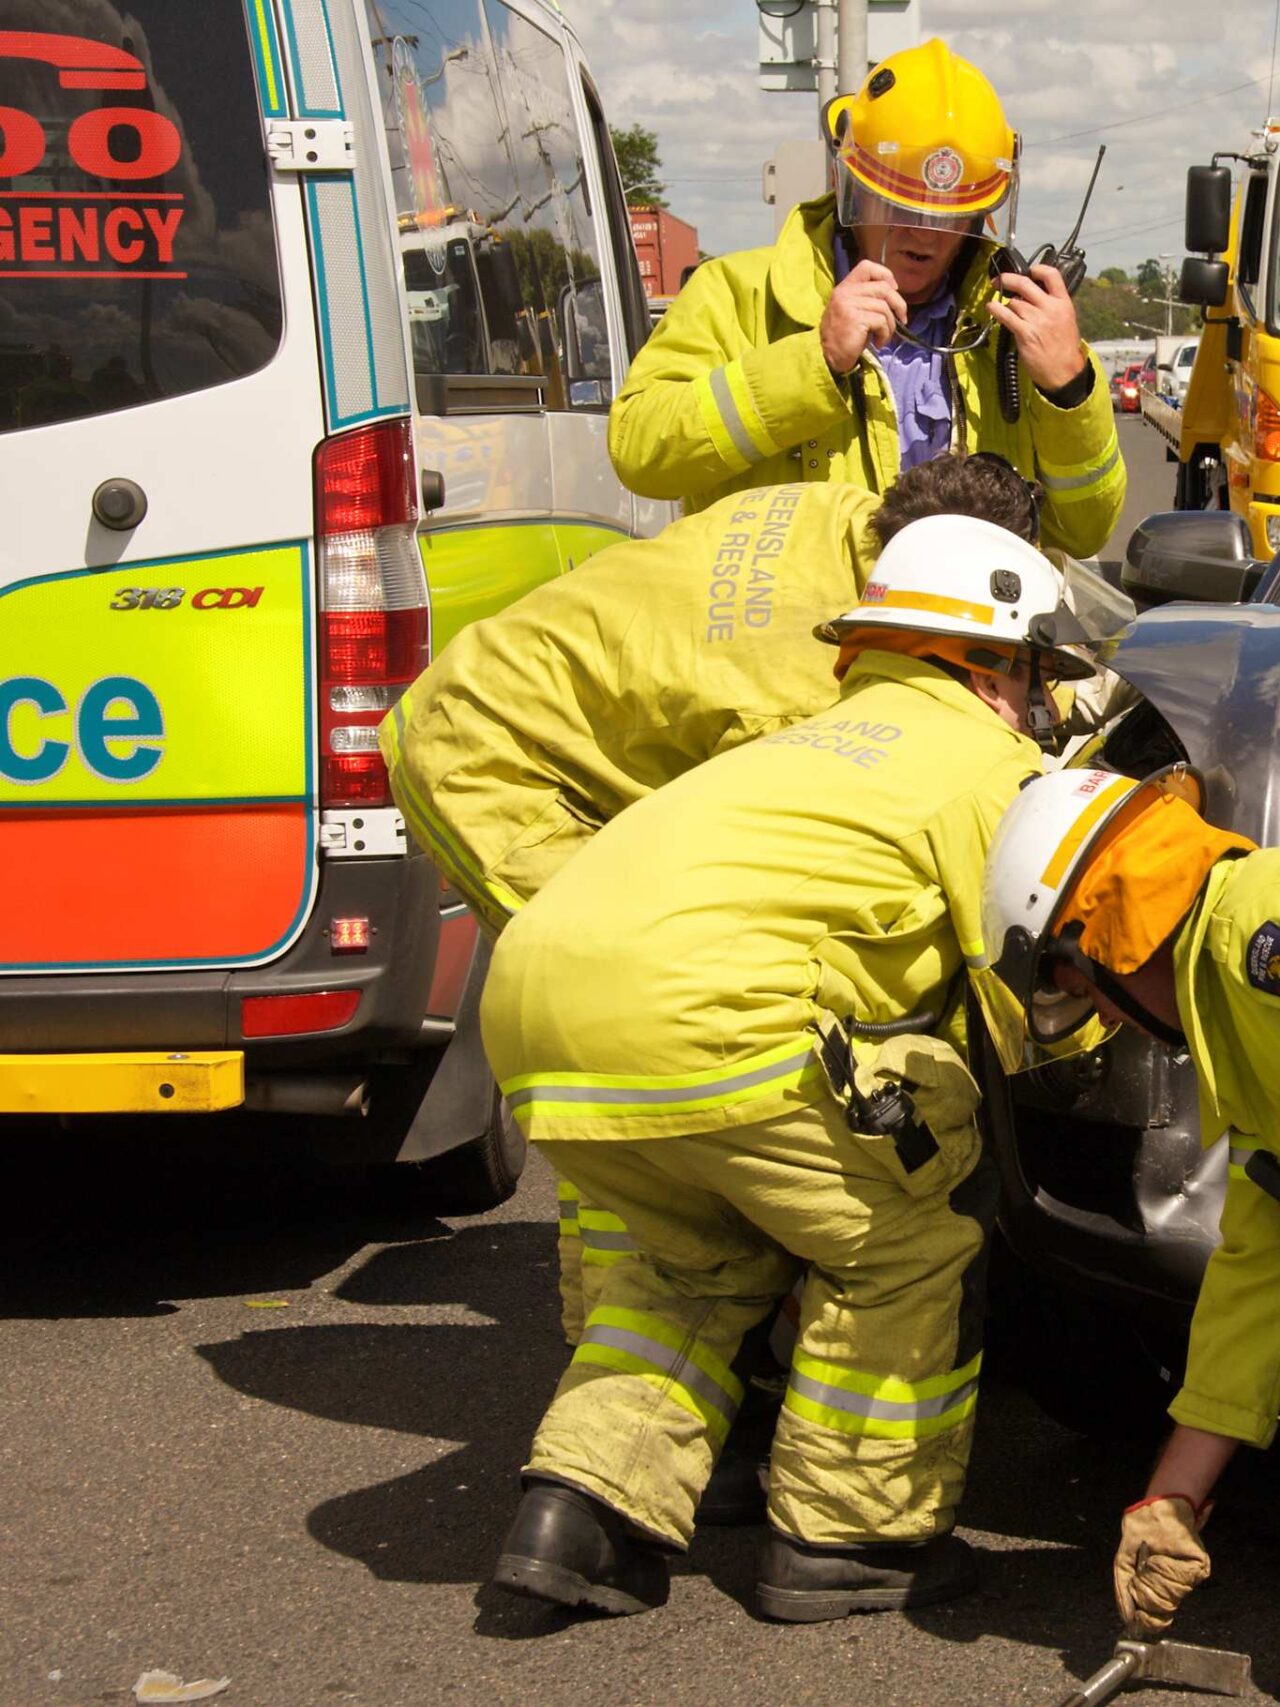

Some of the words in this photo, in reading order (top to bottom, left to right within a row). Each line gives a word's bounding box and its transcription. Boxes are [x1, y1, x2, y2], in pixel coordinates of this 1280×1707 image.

[730, 511, 757, 525] &
[110, 587, 186, 611] 318
[191, 586, 265, 610] CDI
[706, 532, 750, 644] RESCUE
[0, 675, 165, 787] ce
